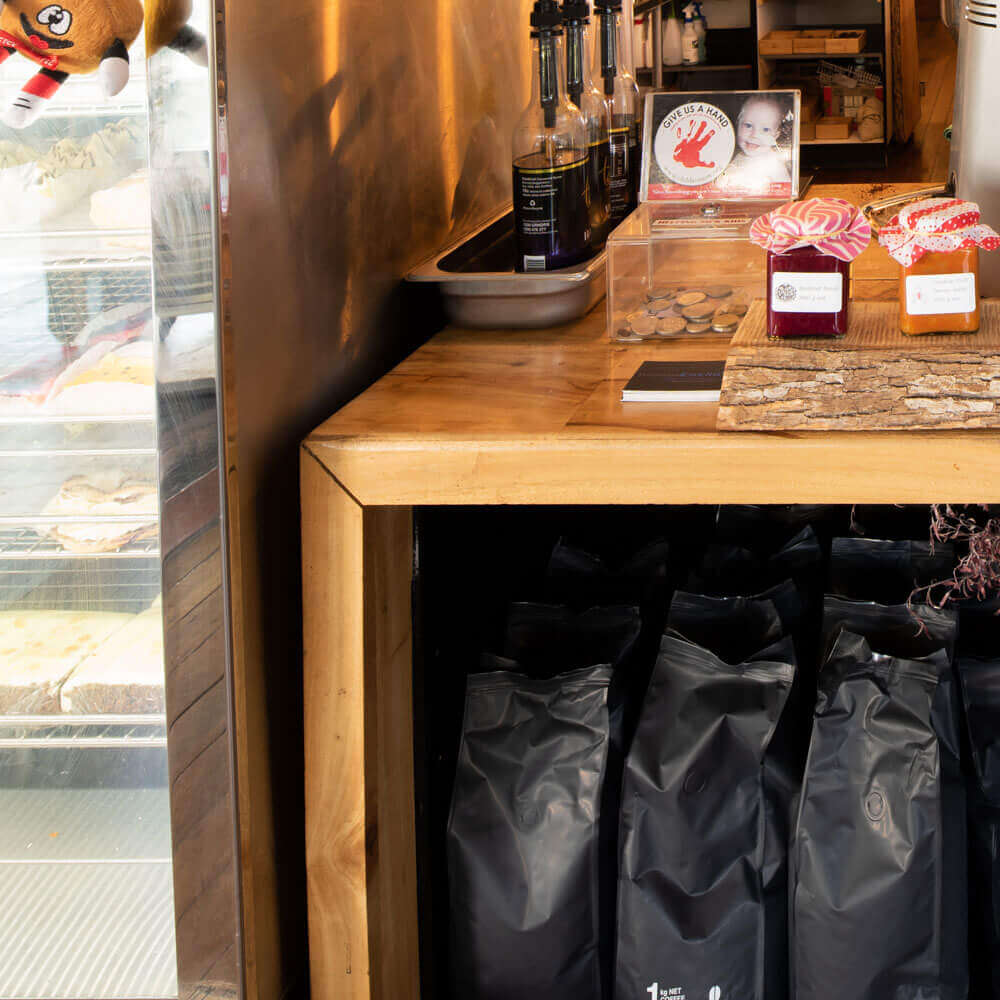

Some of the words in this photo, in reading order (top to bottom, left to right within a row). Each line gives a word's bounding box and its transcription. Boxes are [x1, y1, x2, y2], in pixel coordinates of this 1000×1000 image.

[663, 109, 686, 129] GIVE
[684, 105, 695, 115] US
[706, 106, 729, 129] HAND
[646, 982, 659, 1000] 1
[668, 987, 682, 995] NET
